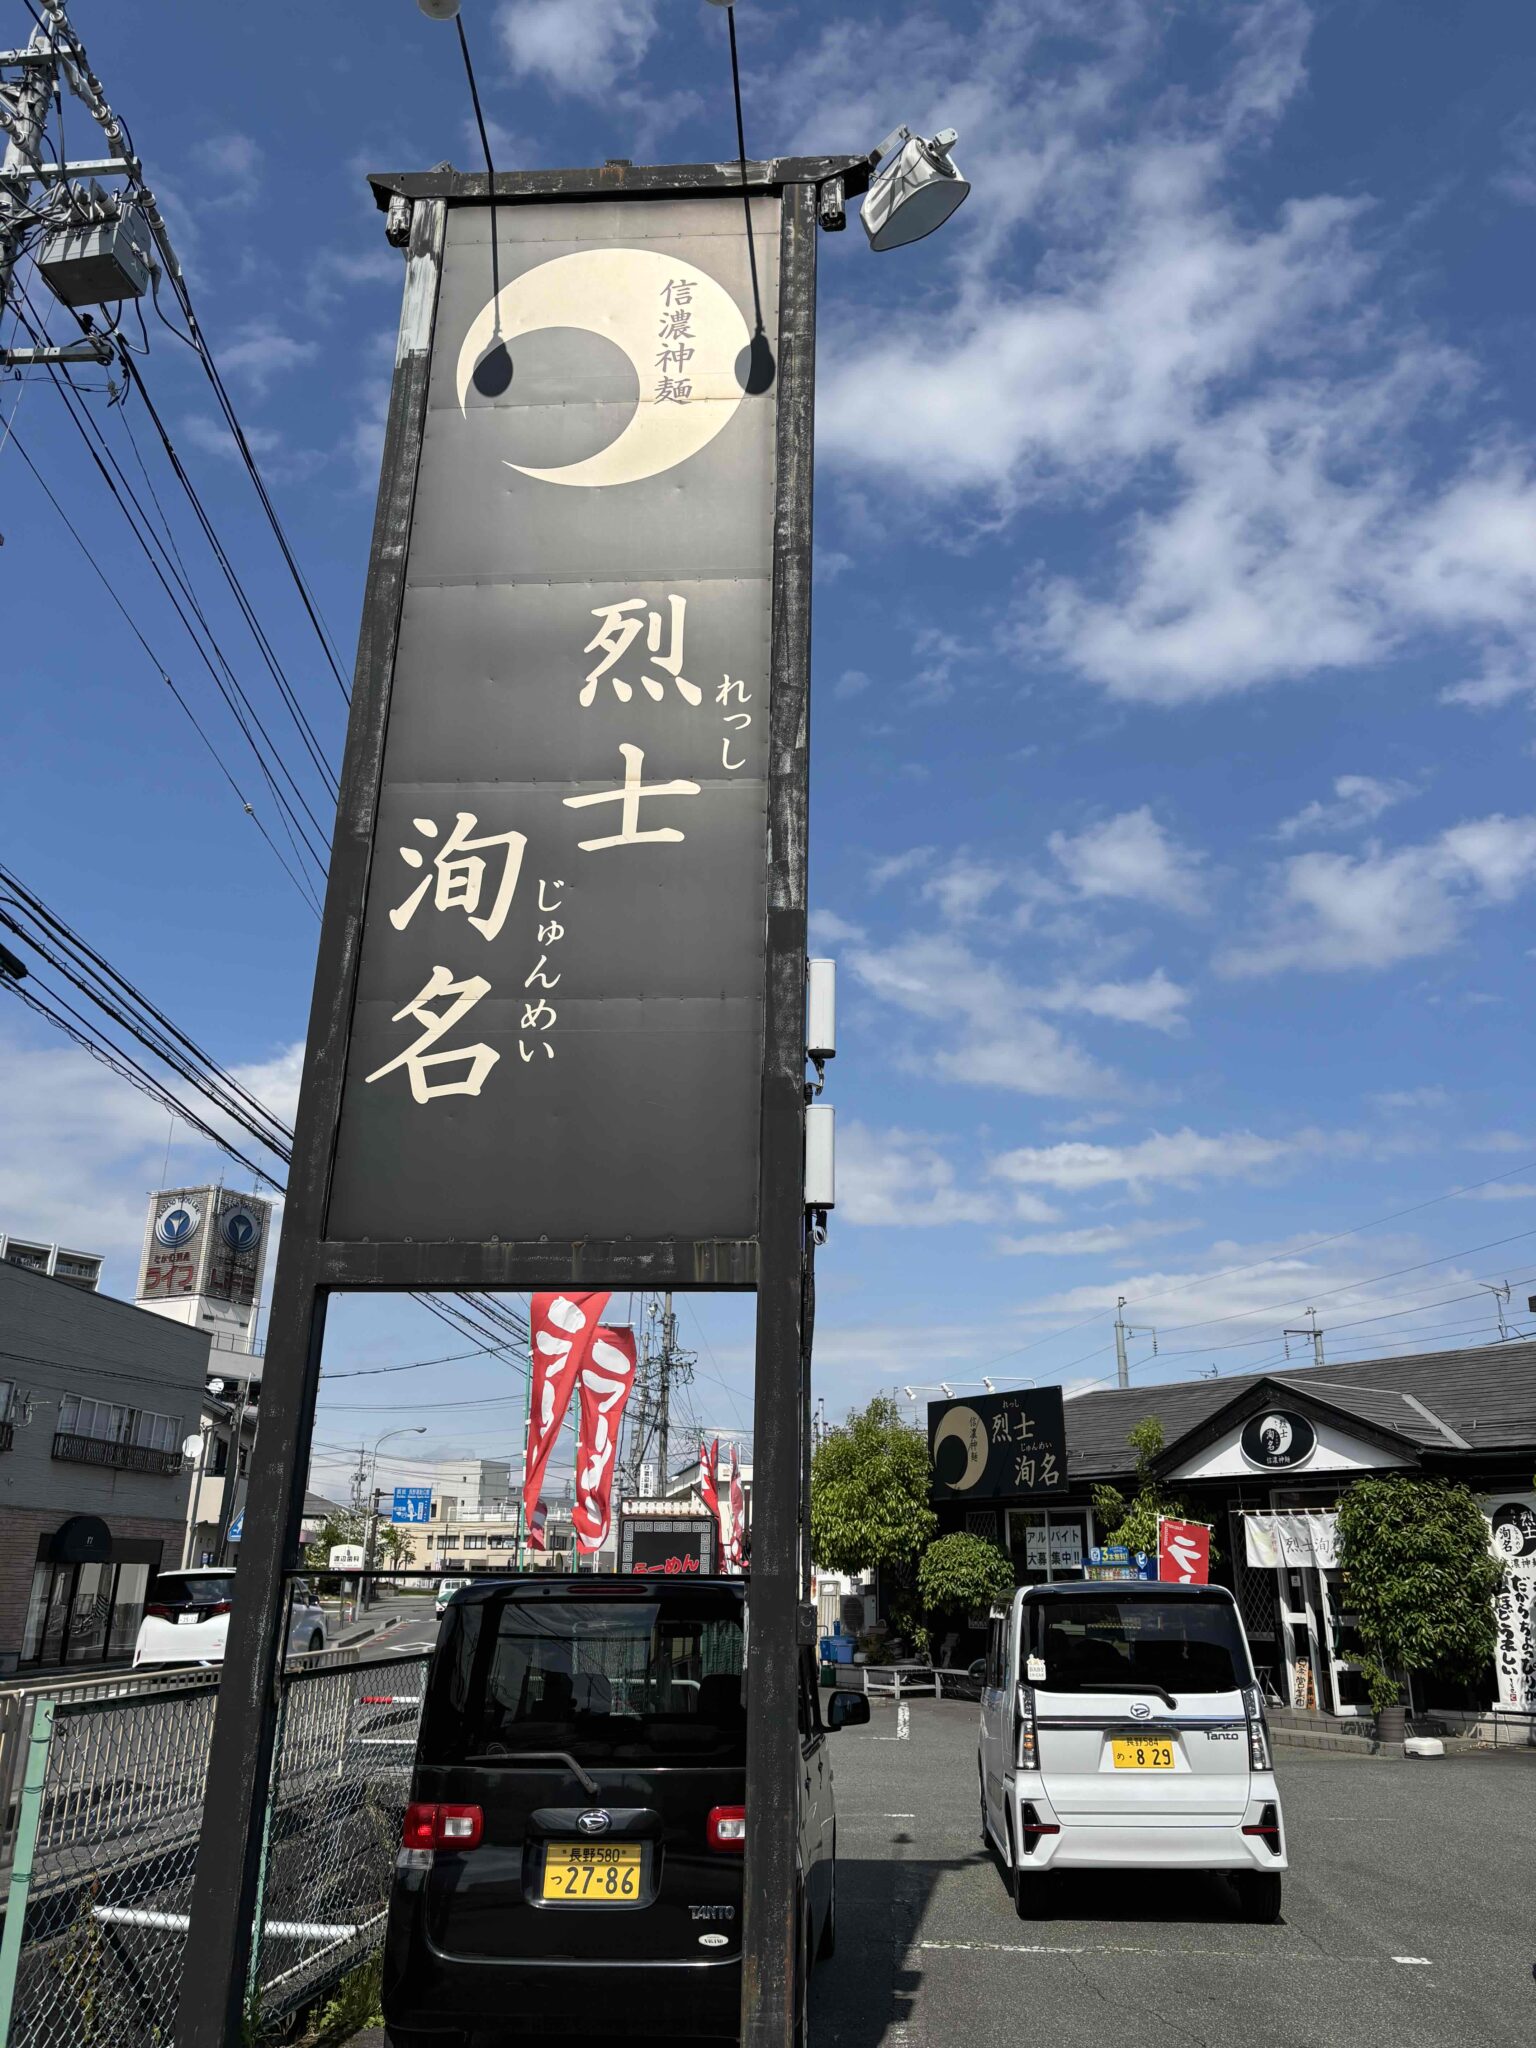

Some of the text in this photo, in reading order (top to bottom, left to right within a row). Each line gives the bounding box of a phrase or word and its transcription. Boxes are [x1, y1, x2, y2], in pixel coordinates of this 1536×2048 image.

[654, 279, 698, 405] 信濃神麺
[563, 594, 702, 851] 烈士
[715, 674, 752, 770] れっし
[365, 812, 527, 1104] 洵名
[519, 878, 565, 1062] じゅんめい
[146, 1265, 194, 1290] ライフ
[1002, 1399, 1020, 1409] れっし
[992, 1412, 1035, 1443] 烈士
[1020, 1442, 1053, 1452] じゅんめい
[1014, 1453, 1060, 1488] 洵名
[1027, 1529, 1079, 1544] アルバイト
[1286, 1537, 1335, 1554] 烈士洵
[633, 1554, 700, 1574] らーめん
[1204, 1731, 1239, 1741] Tanto
[569, 1848, 620, 1863] 長野580
[688, 1905, 735, 1920] TANTO
